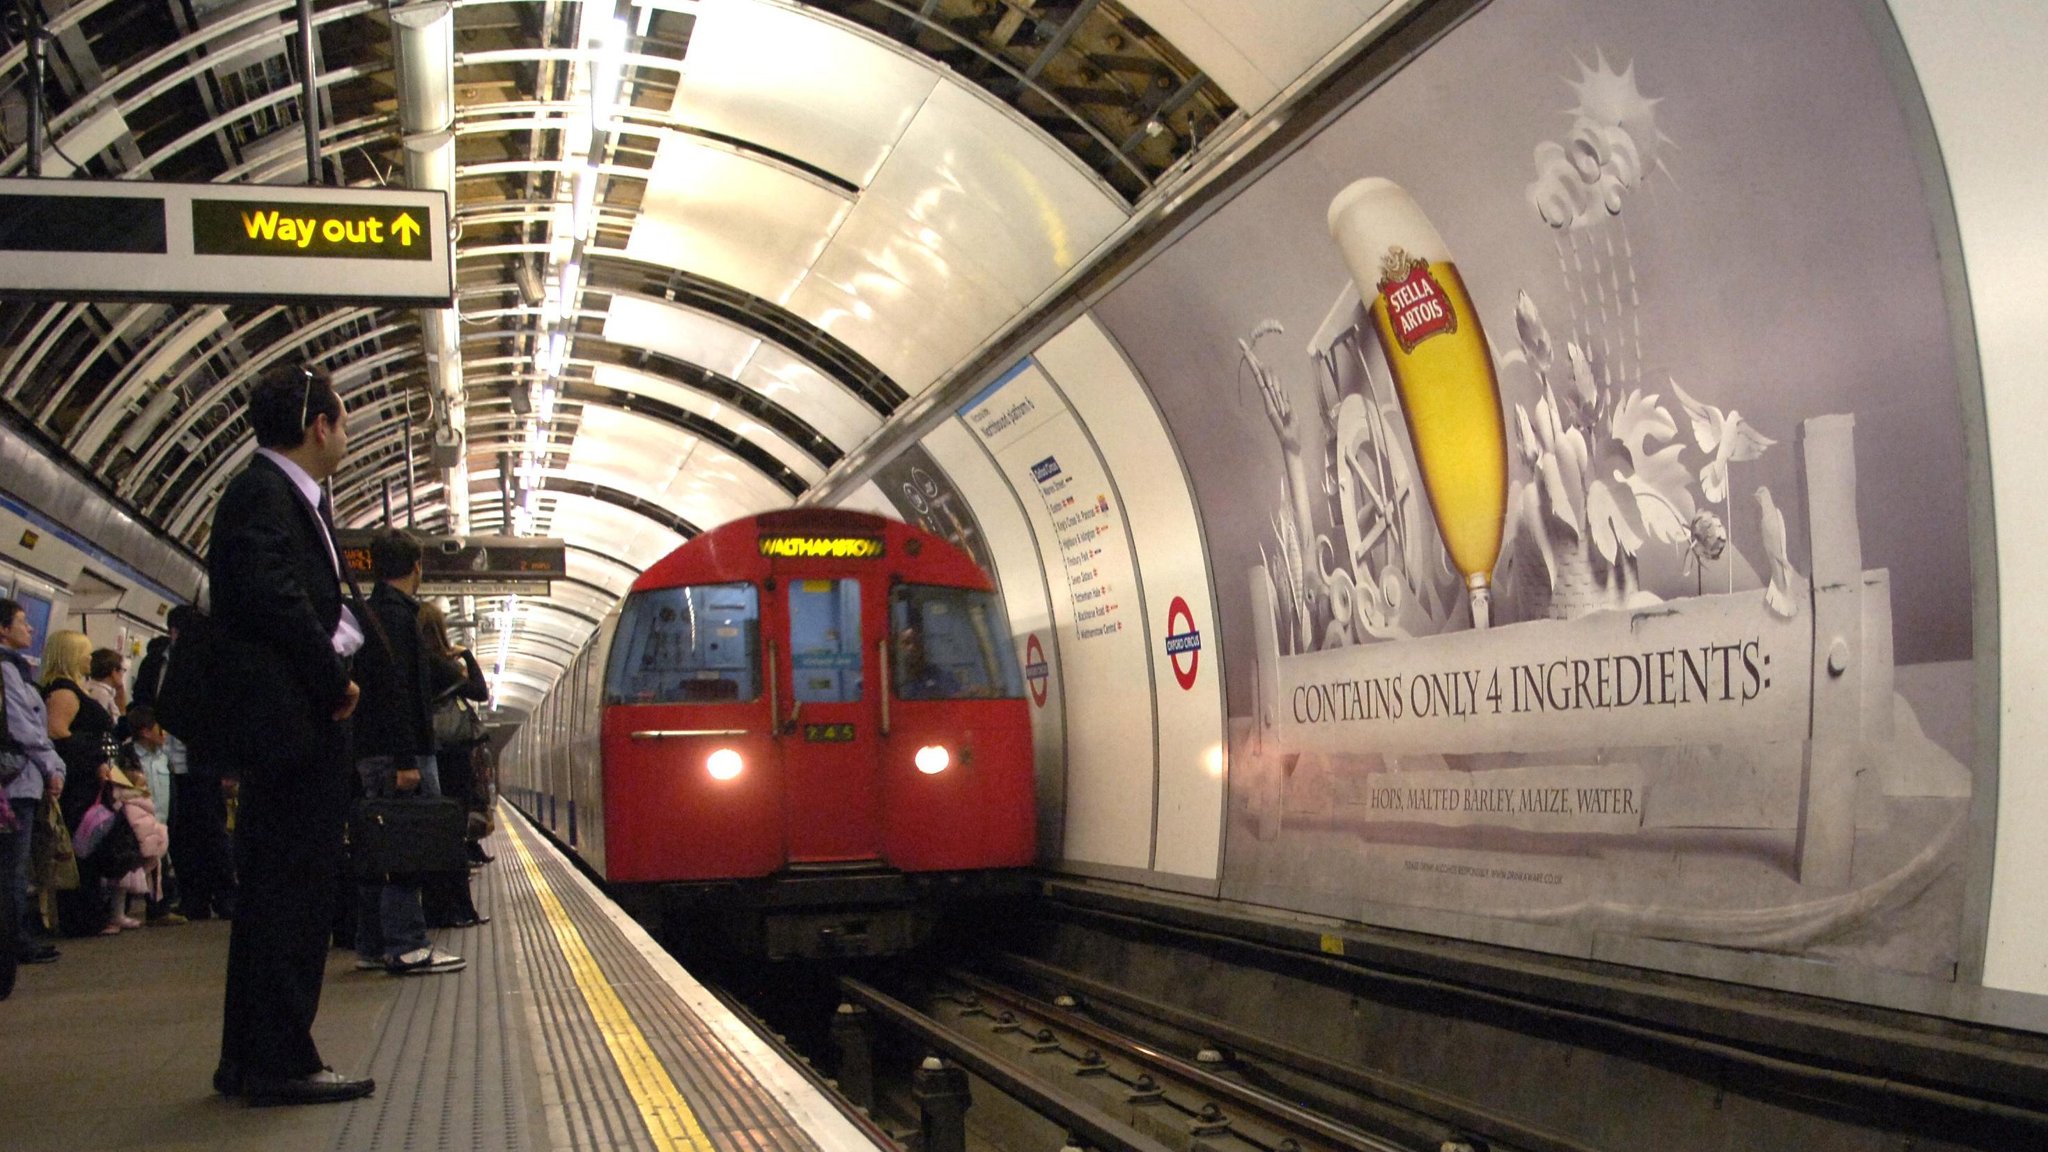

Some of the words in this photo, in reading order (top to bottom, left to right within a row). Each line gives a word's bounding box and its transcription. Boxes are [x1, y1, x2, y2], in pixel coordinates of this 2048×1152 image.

[241, 211, 316, 248] Way
[322, 217, 383, 243] out
[1390, 278, 1434, 313] STELLA
[1400, 298, 1443, 334] ARTOIS
[1167, 638, 1184, 651] OXFORD
[1184, 635, 1199, 648] CIRCUS
[1293, 672, 1403, 724] CONTAINS
[1410, 669, 1481, 721] ONLY
[1486, 666, 1502, 713] 4
[1510, 636, 1771, 712] INGREDIENTS:
[1371, 787, 1404, 812] HOPS,
[1406, 788, 1460, 812] MALTED
[1463, 788, 1515, 816] BARLEY,
[1518, 788, 1573, 817] MAIZE,
[1577, 788, 1639, 815] WATER.
